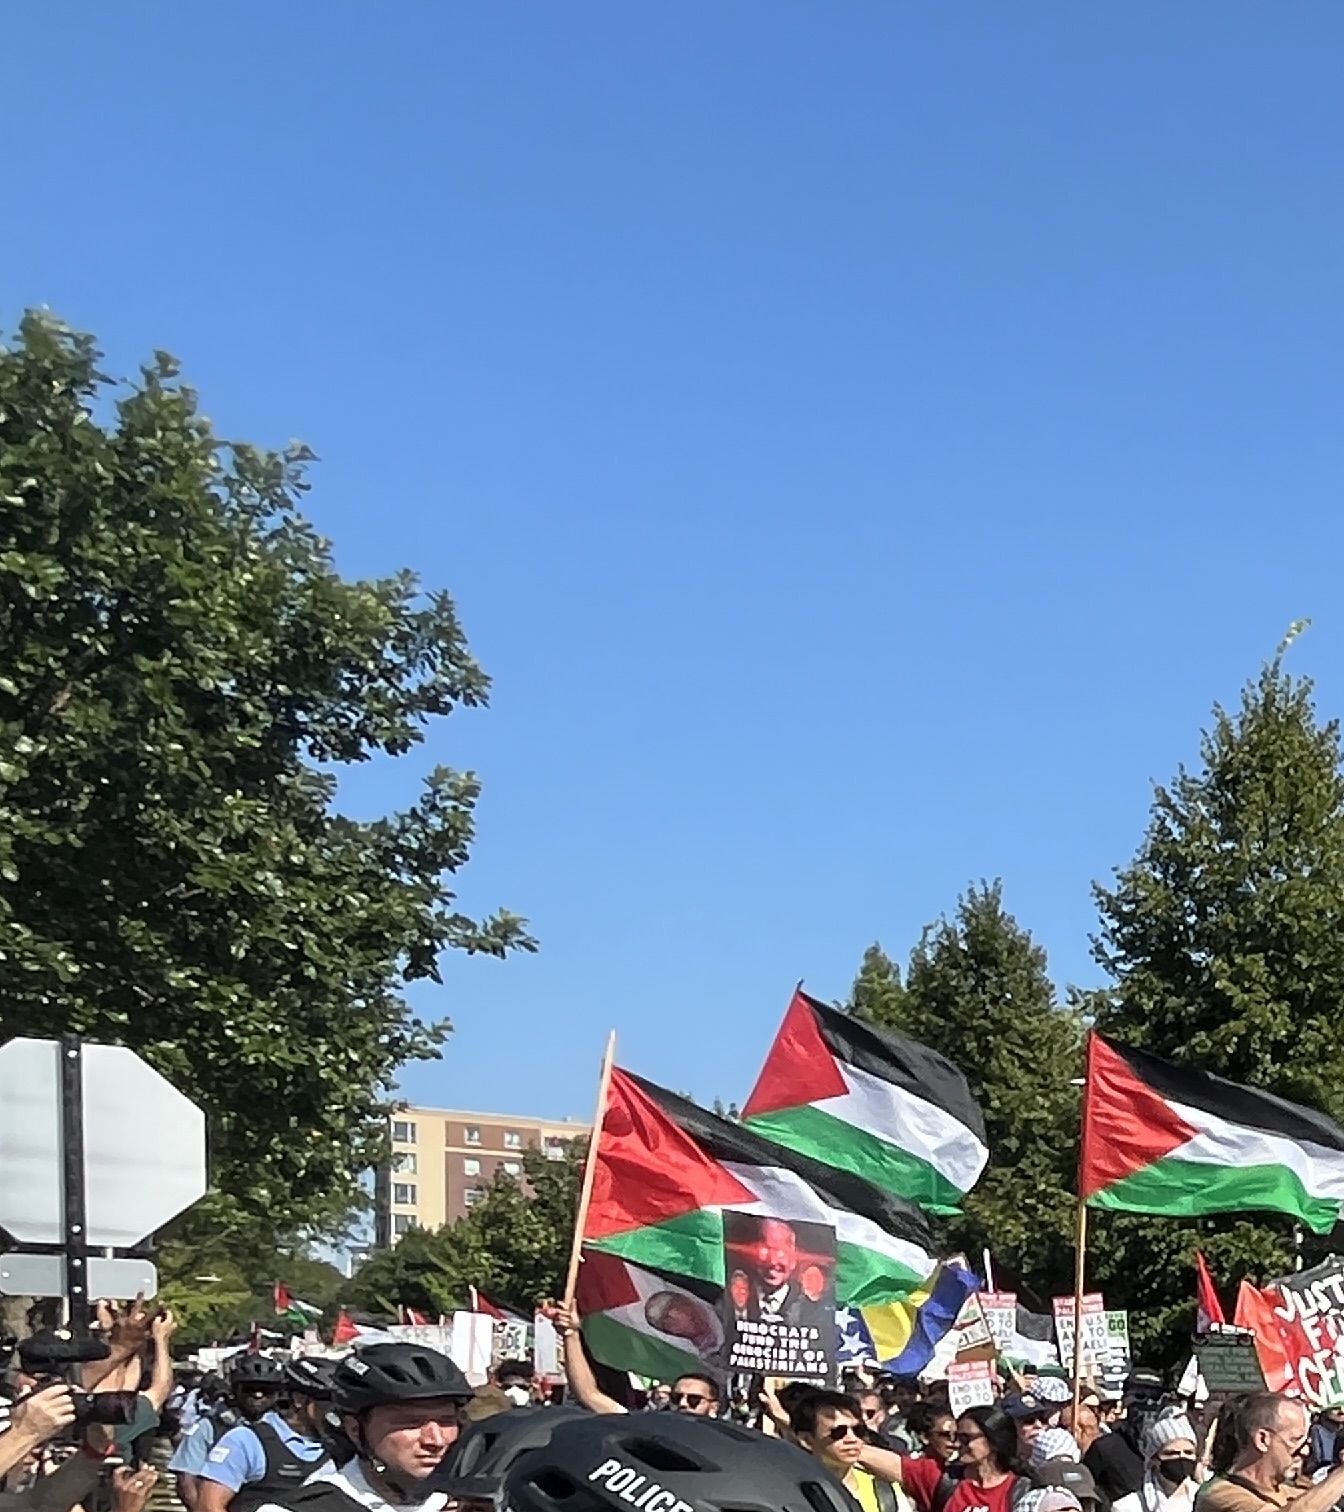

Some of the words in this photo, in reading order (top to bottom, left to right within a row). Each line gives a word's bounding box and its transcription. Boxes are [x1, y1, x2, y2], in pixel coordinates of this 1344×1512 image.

[736, 1320, 819, 1340] DEMOCRATS
[742, 1332, 775, 1348] FUND
[1089, 1326, 1105, 1338] TO
[732, 1342, 797, 1360] GENOCIDE
[803, 1349, 825, 1362] OF
[730, 1354, 828, 1374] PALESTINIANS
